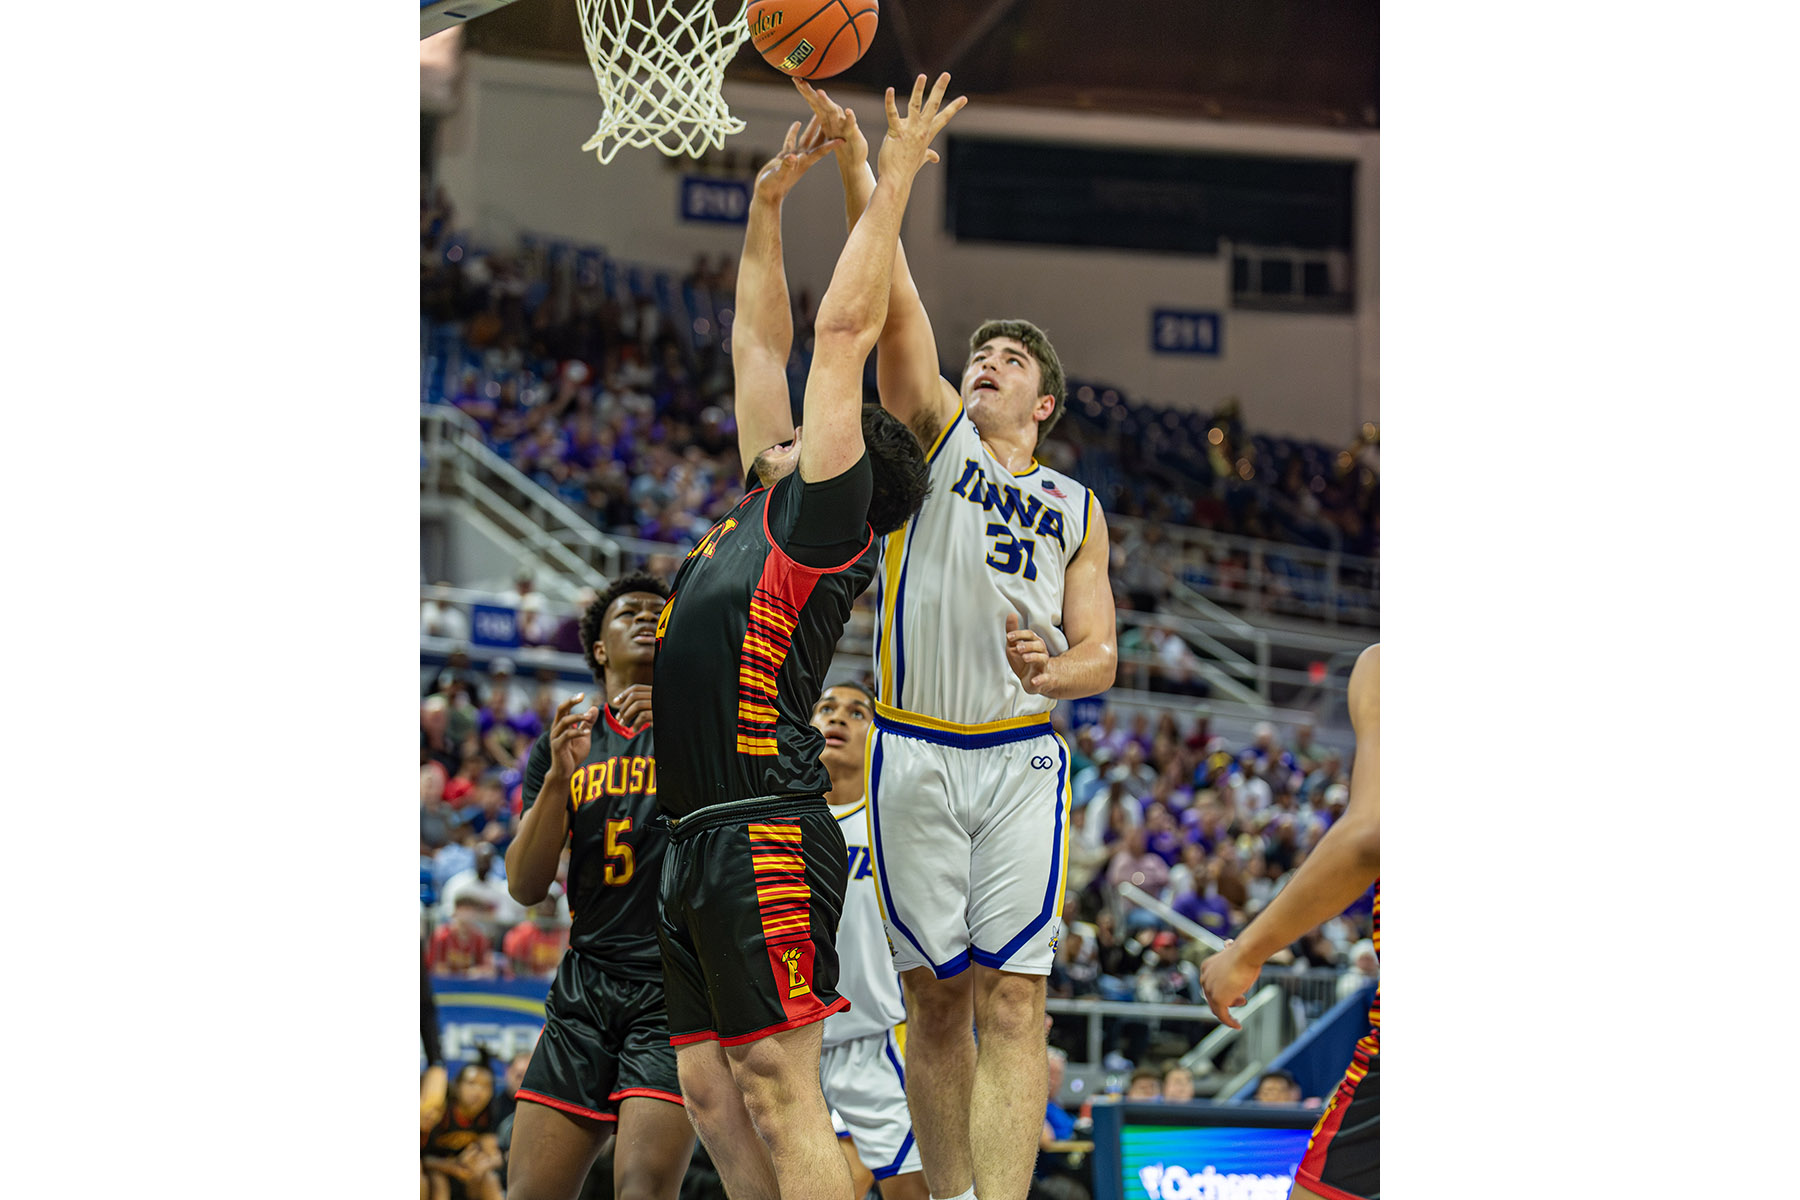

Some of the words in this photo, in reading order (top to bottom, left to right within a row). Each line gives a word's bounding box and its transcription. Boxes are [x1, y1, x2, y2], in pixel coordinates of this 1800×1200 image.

[950, 457, 1066, 554] IOWA
[985, 521, 1038, 582] 31
[604, 816, 636, 886] 5
